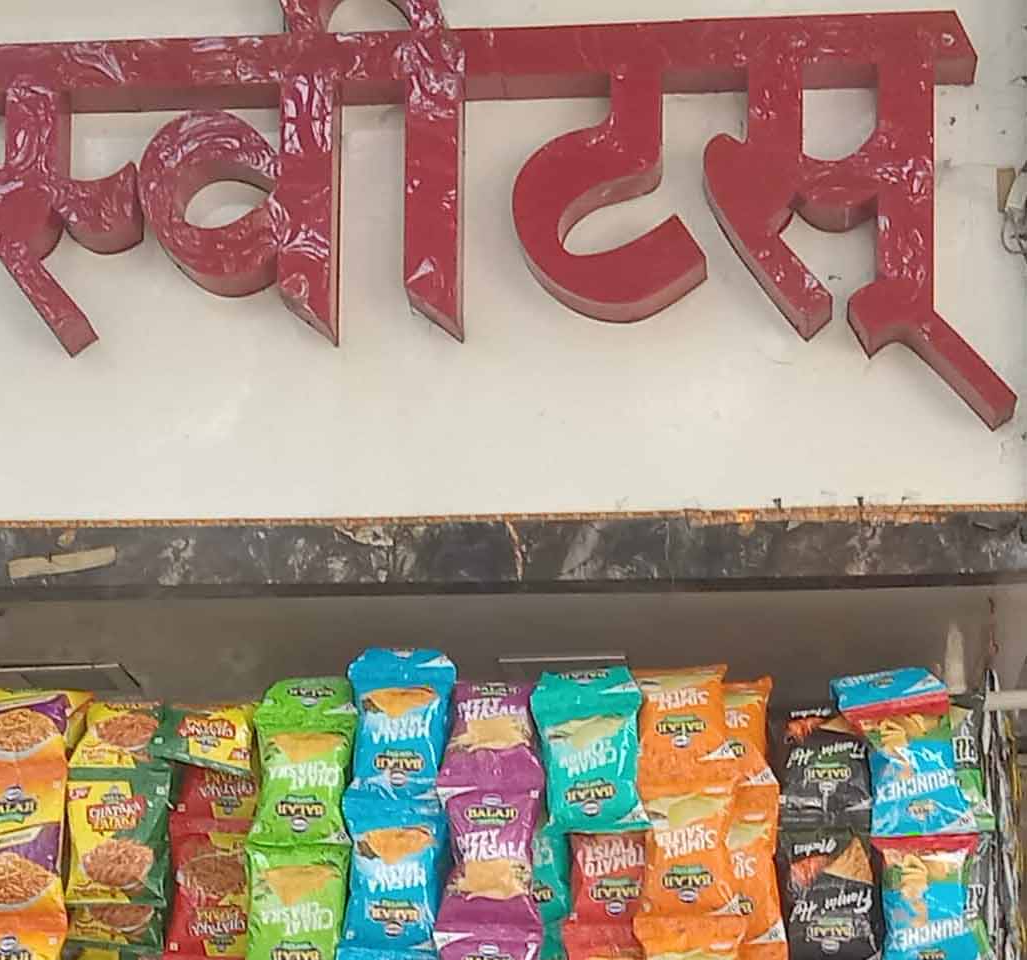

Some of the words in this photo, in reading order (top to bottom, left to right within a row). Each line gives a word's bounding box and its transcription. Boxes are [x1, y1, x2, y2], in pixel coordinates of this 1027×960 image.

[657, 690, 710, 711] SIMPLY
[463, 703, 527, 722] MASALA
[372, 720, 430, 744] MASALA
[657, 721, 706, 734] BALAJI
[376, 757, 423, 770] BALAJI
[567, 784, 615, 800] BALAJI
[276, 801, 324, 817] BALAJI
[468, 808, 516, 821] BALAJI
[463, 839, 527, 860] MASALA
[663, 832, 718, 858] SIMPLY
[584, 851, 645, 877] TOMATO
[367, 867, 427, 892] MASALA
[663, 873, 712, 886] BALAJI
[591, 886, 640, 899] BALAJI
[371, 908, 420, 921] BALAJI
